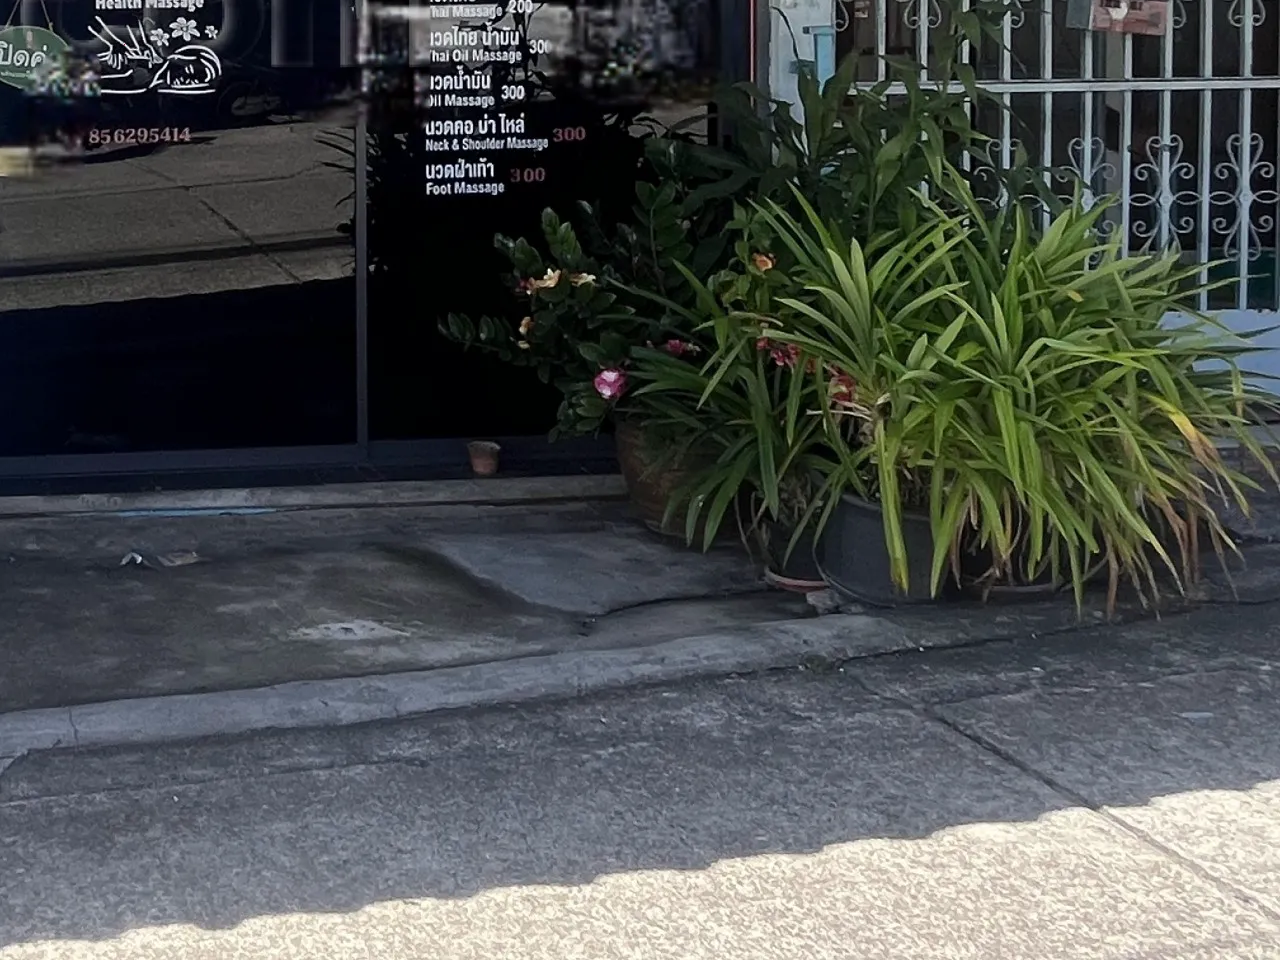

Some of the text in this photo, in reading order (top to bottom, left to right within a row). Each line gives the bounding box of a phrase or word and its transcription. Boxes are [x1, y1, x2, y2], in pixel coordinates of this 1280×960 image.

[430, 5, 503, 20] hai Massage
[508, 0, 533, 14] 200
[430, 49, 522, 64] hai Oil Massage
[501, 85, 525, 100] 300
[445, 94, 495, 108] Massage
[553, 126, 586, 142] 300
[425, 137, 548, 151] Neck & Shoulder Massage
[510, 167, 546, 183] 300
[426, 181, 505, 196] Foot Massage
